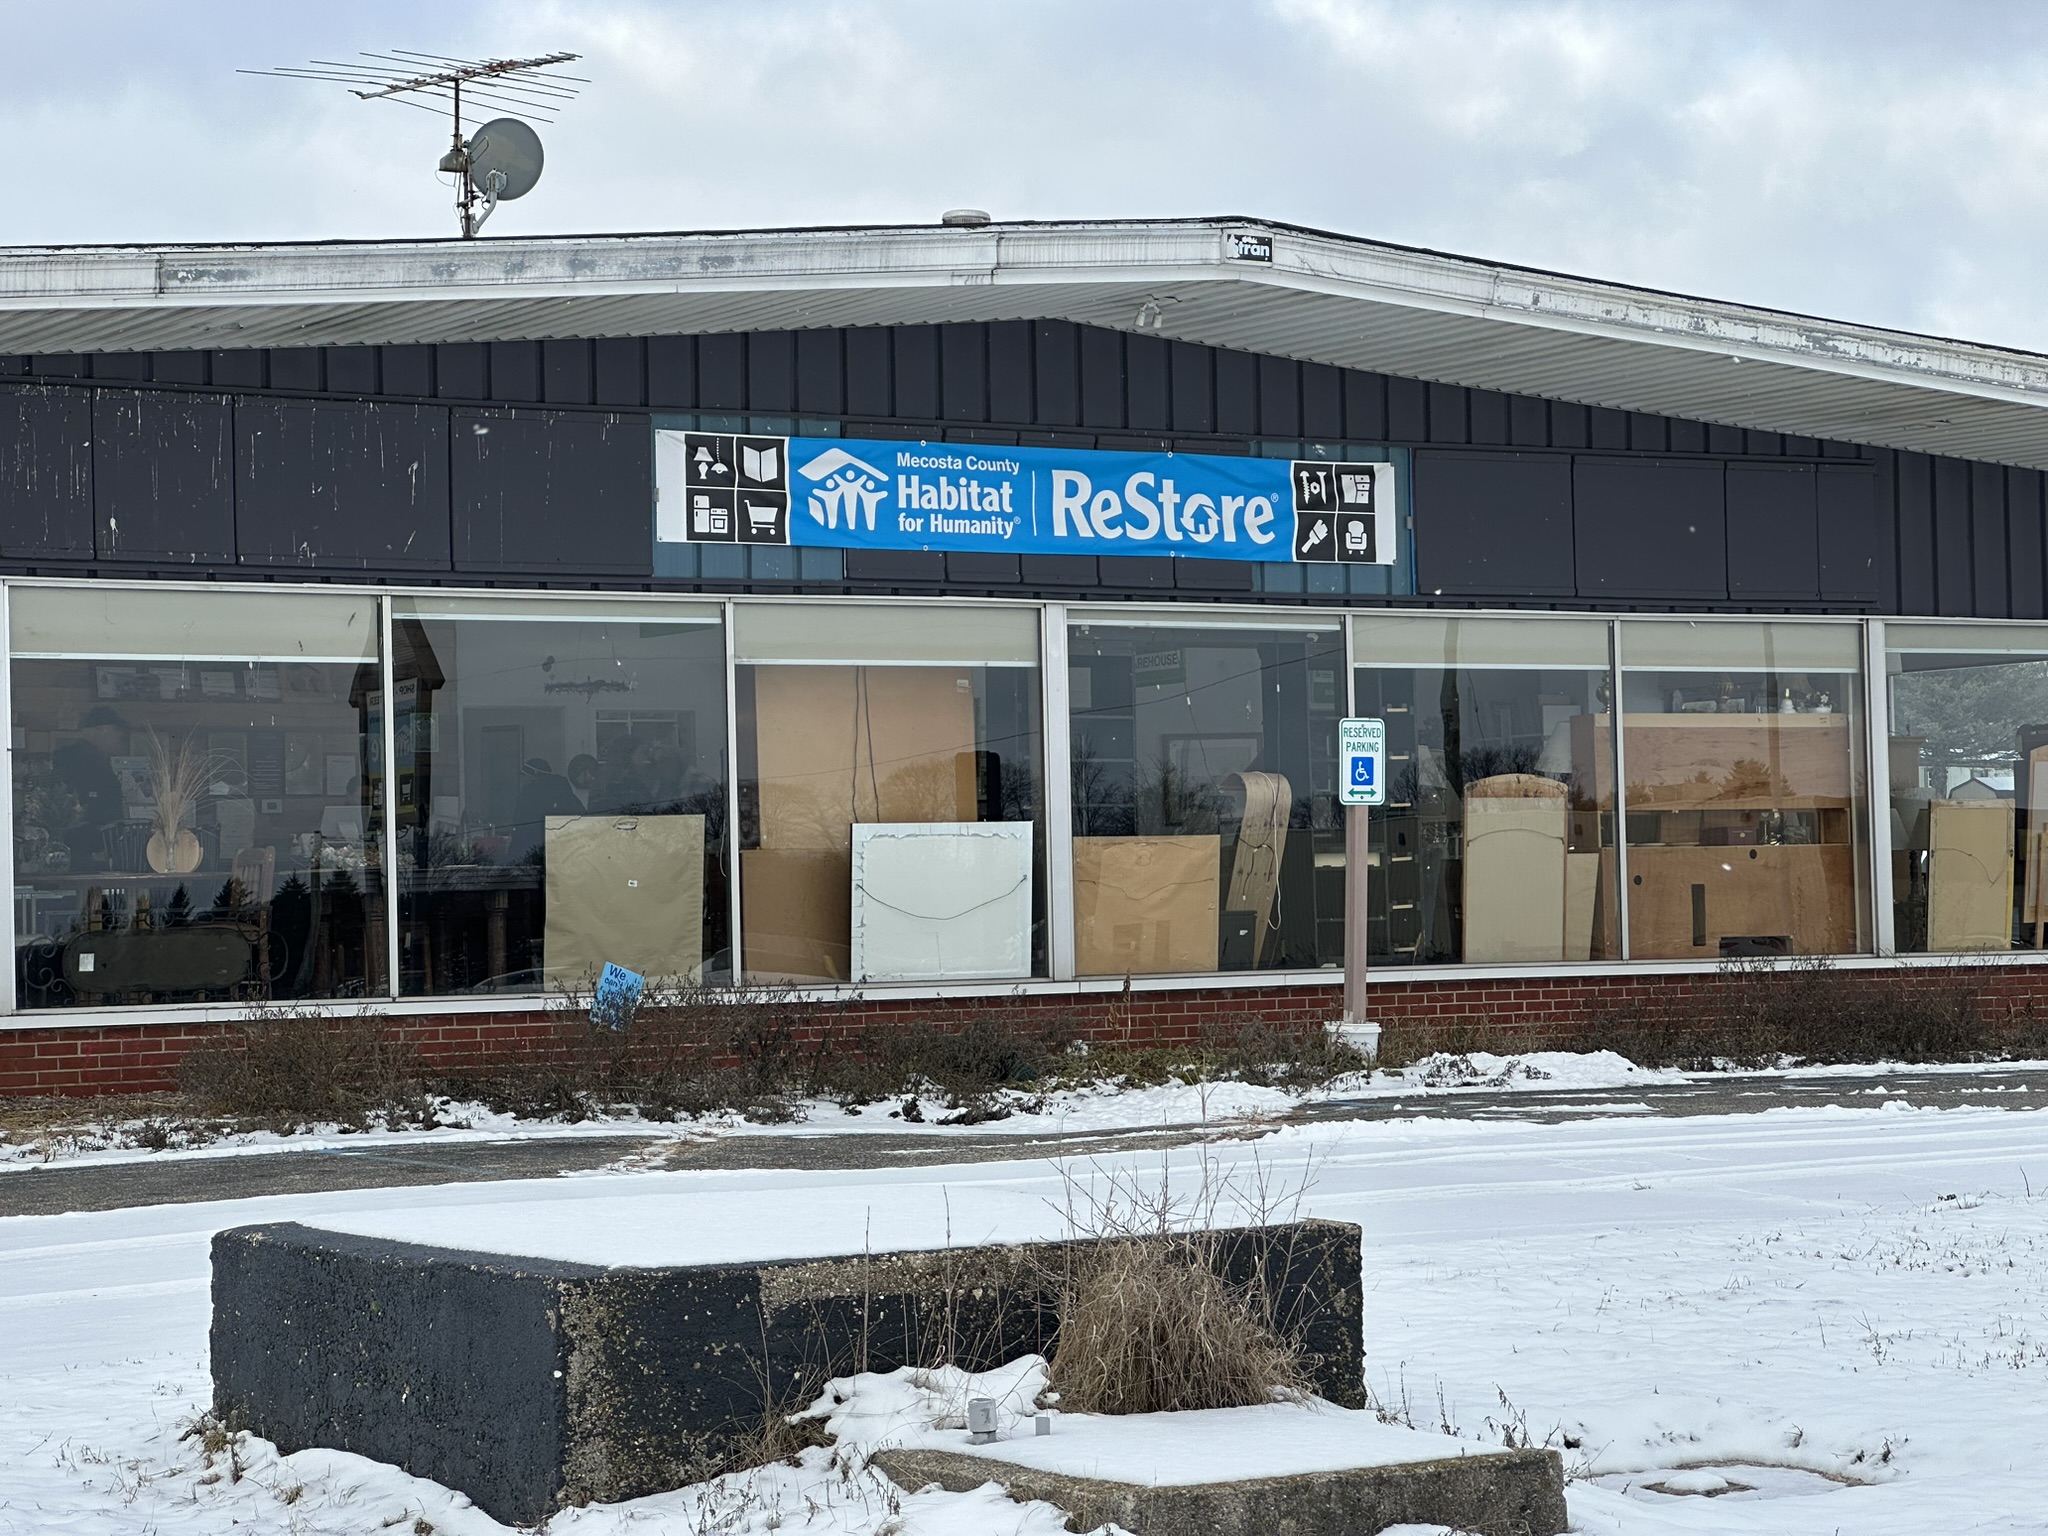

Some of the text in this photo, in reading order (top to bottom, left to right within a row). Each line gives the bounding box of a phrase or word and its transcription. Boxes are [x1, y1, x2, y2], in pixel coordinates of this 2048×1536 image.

[896, 452, 1020, 475] Mecosta County
[897, 474, 1013, 513] Habitat
[898, 512, 925, 532] for
[1343, 727, 1382, 738] RESERVED
[1346, 742, 1379, 752] PARKING
[610, 965, 626, 980] We
